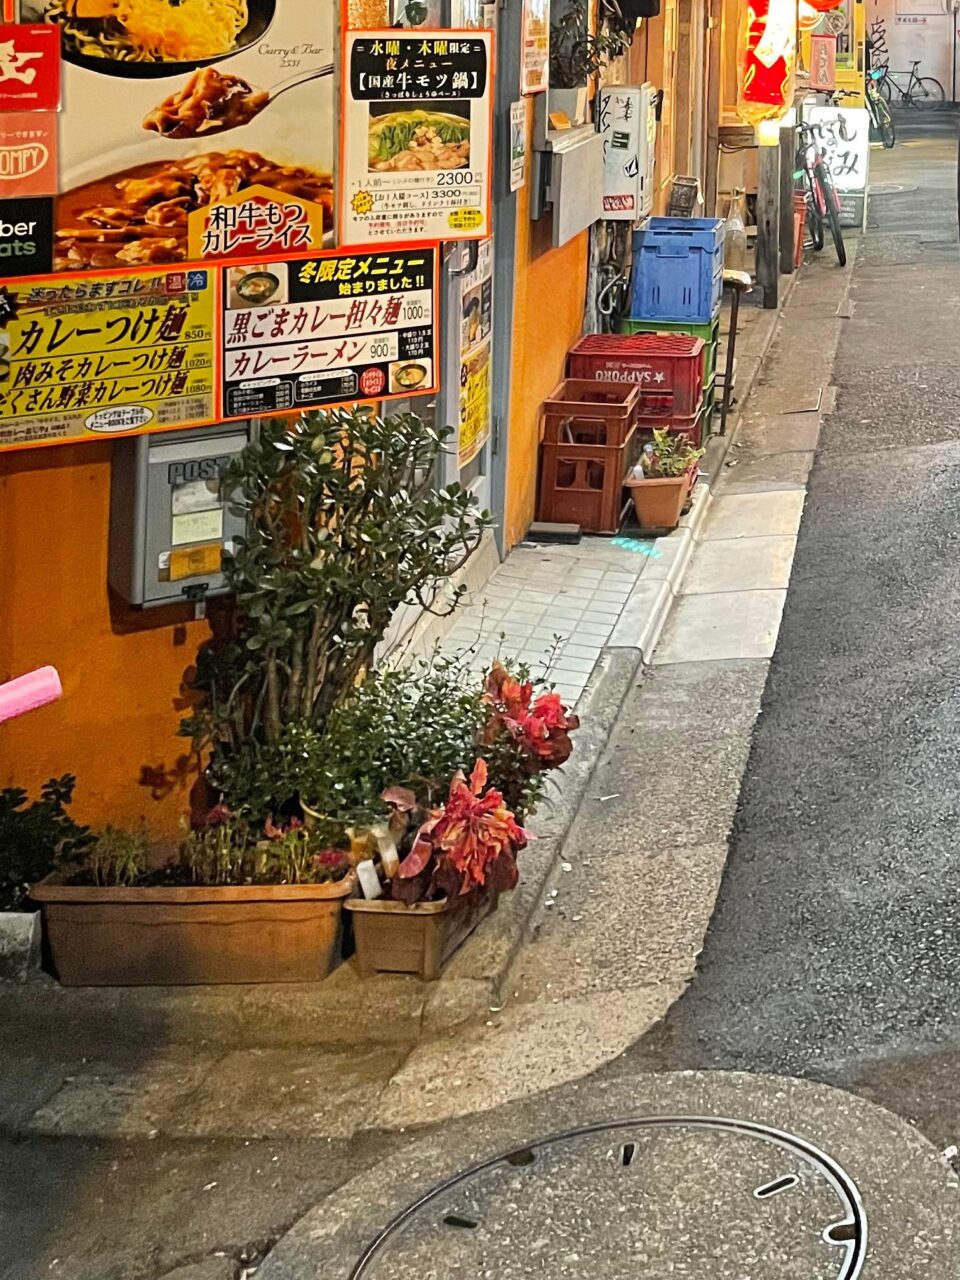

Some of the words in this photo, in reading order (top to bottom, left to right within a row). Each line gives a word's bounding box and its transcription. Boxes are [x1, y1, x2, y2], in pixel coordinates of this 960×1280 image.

[210, 203, 303, 230] 和牛もつ
[202, 225, 313, 253] カレーライス
[298, 257, 425, 284] 冬限定メニュー
[12, 303, 191, 357] カレーつけ麺
[227, 295, 404, 345] 黒ごまカレー担々麺
[13, 345, 188, 389] 肉みそカレーつけ麺
[229, 340, 367, 379] カレーラーメン
